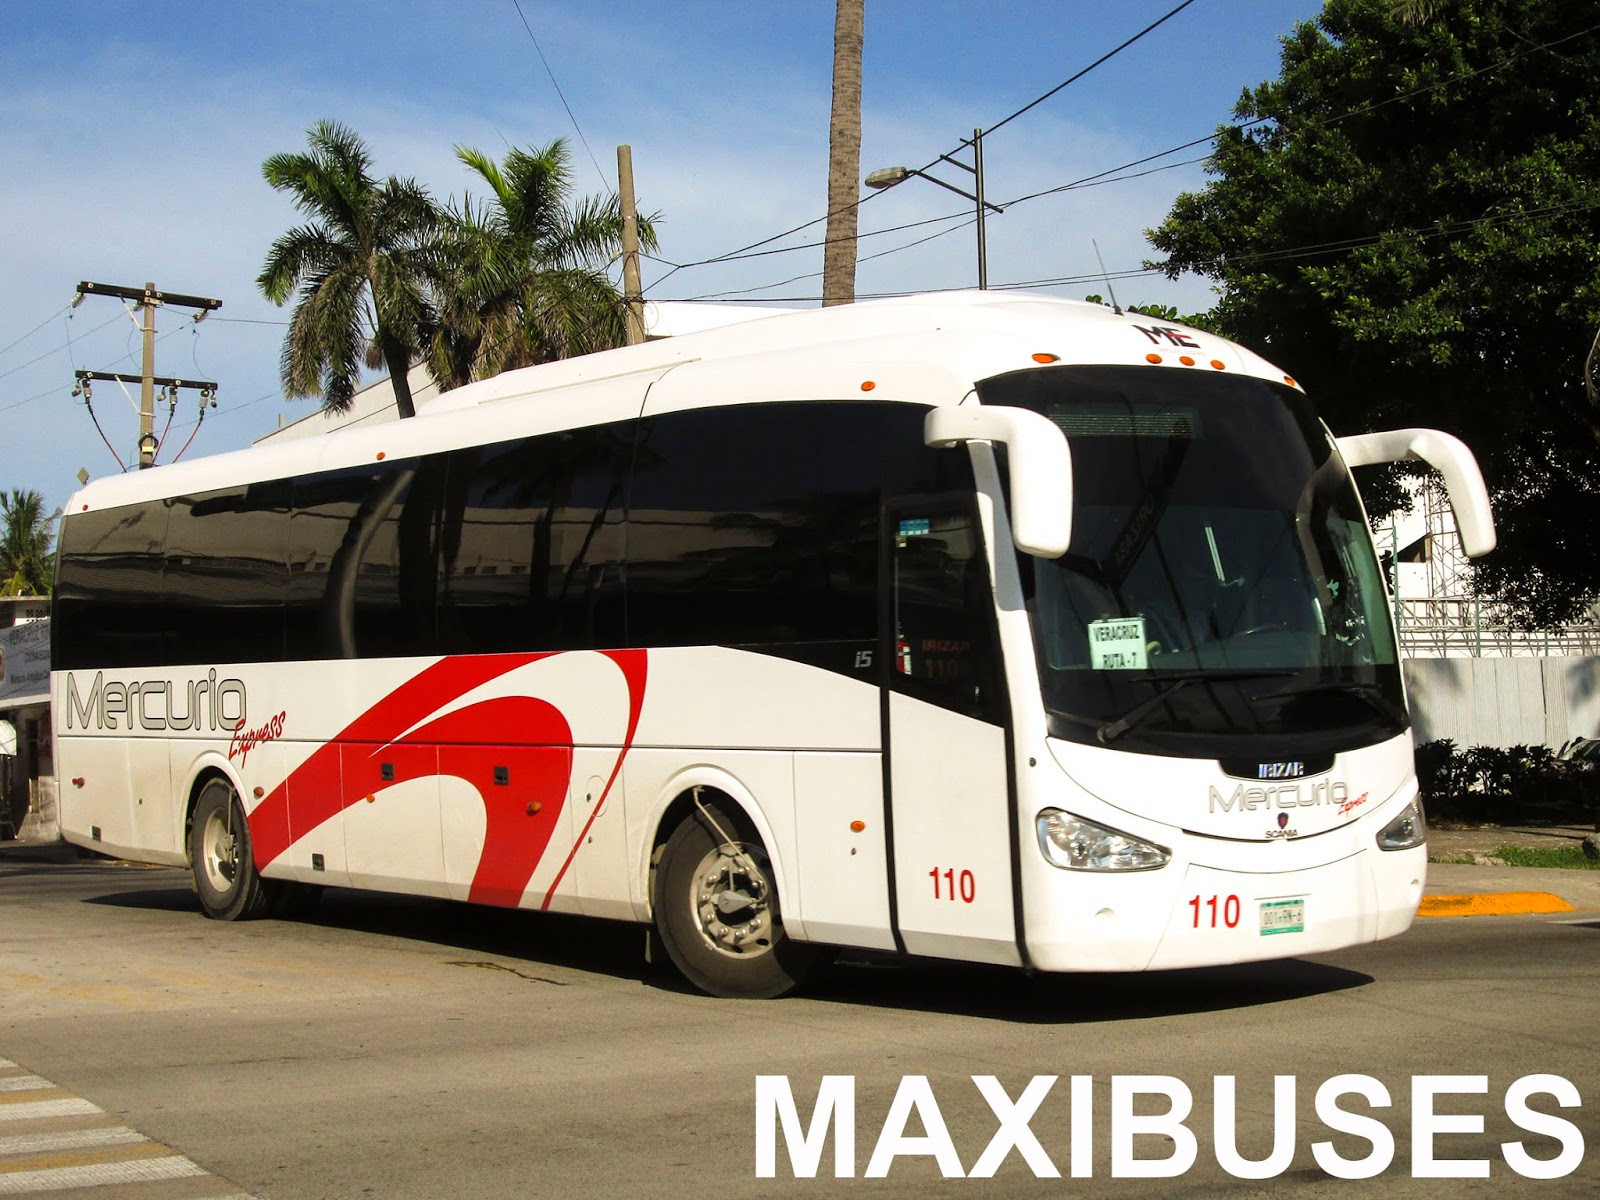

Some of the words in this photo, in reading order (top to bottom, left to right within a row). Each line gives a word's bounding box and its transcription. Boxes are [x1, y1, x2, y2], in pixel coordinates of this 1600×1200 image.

[1093, 624, 1140, 641] VERACRUZ
[854, 651, 872, 668] i5
[1103, 653, 1125, 669] RUTA
[67, 668, 247, 731] Mercurio
[229, 710, 286, 769] Express
[1258, 762, 1303, 778] IRIZAR
[1209, 778, 1348, 813] Mercurio
[1265, 829, 1298, 838] SCANIA
[928, 866, 975, 903] 110
[1189, 894, 1240, 928] 110
